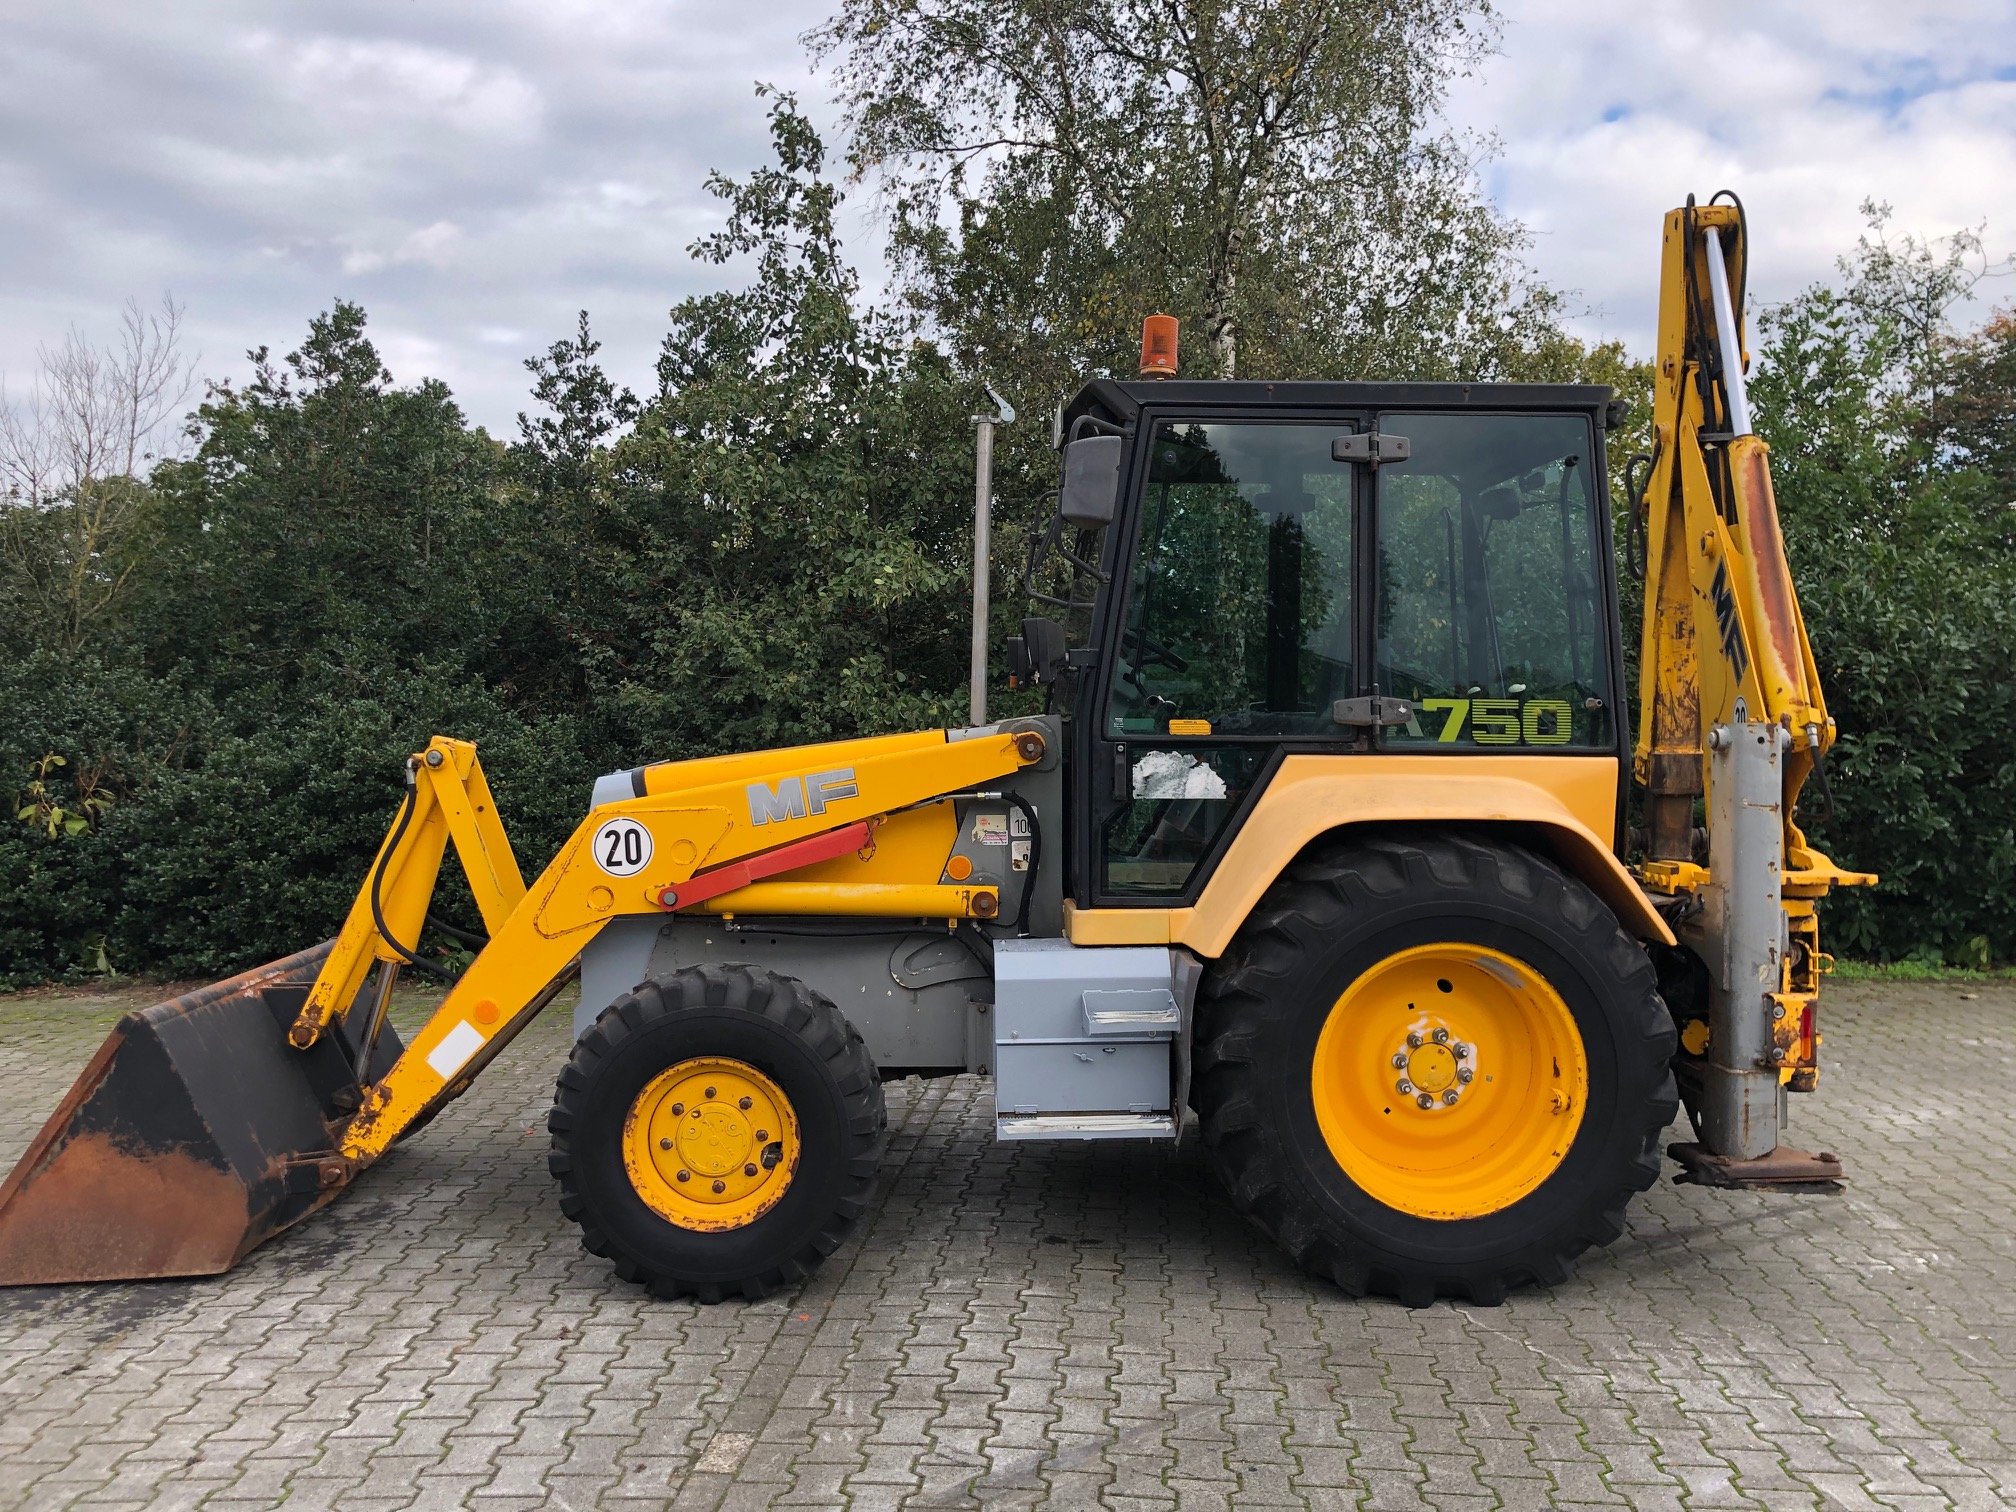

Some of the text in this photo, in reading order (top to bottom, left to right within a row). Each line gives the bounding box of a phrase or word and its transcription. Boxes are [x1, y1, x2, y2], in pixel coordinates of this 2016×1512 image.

[1710, 555, 1748, 687] MF
[1422, 698, 1571, 745] 750
[746, 767, 858, 826] MF
[604, 828, 642, 867] 20
